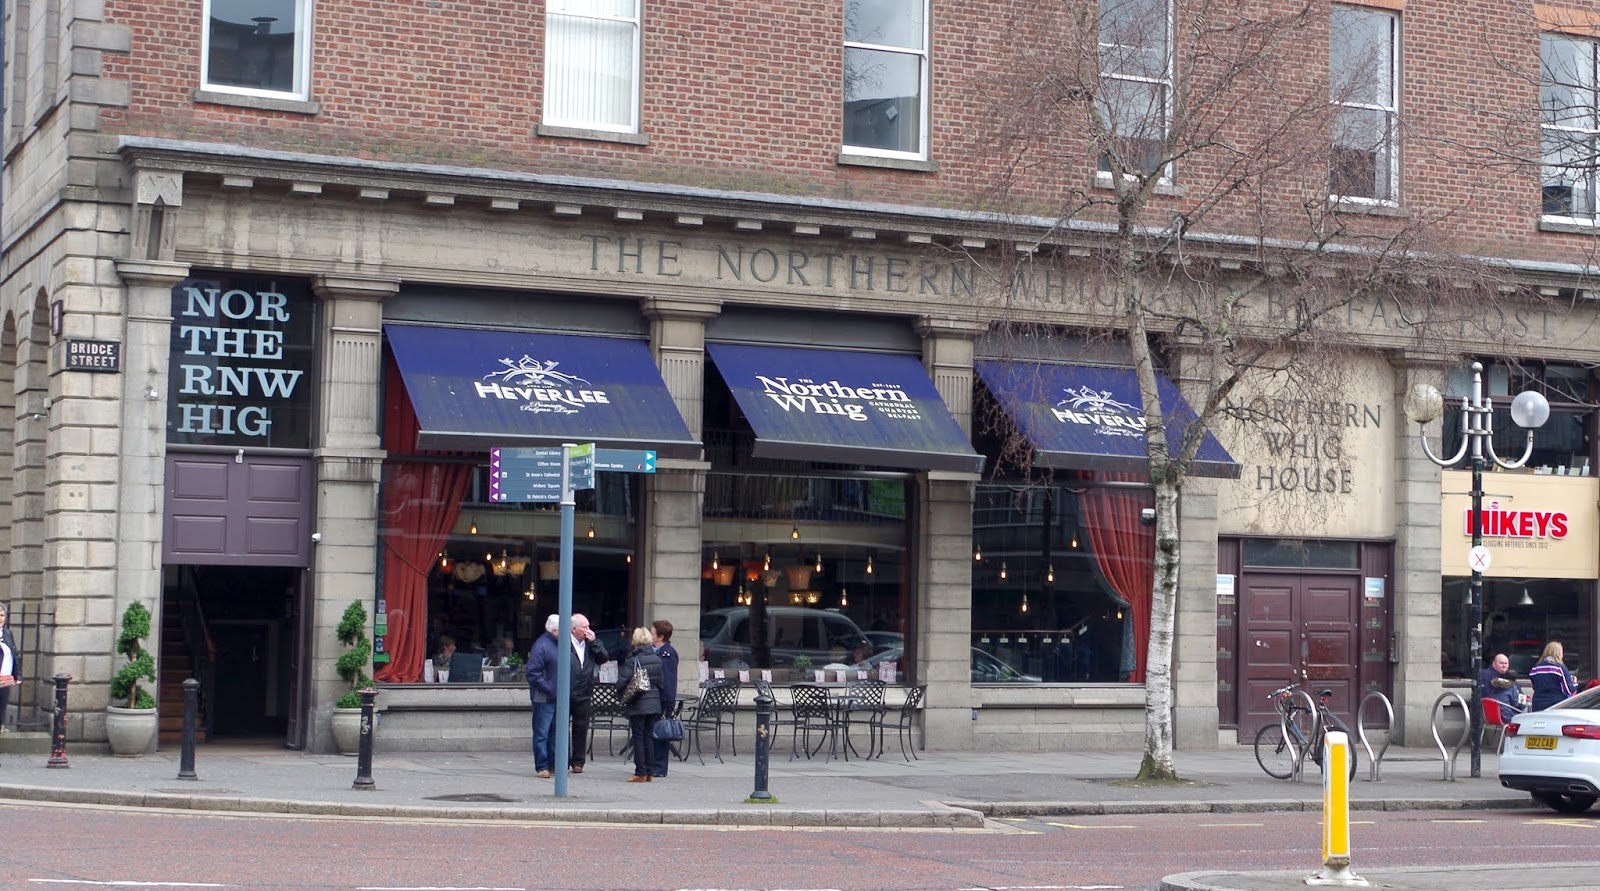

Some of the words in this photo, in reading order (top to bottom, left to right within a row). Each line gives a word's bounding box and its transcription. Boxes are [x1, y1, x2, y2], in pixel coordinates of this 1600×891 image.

[581, 234, 683, 277] THE
[716, 245, 975, 297] NORTHERN
[182, 287, 290, 322] NOR
[71, 343, 113, 355] BRIDGE
[180, 326, 283, 360] THE
[71, 356, 116, 367] STREET
[179, 364, 303, 398] RNW
[474, 381, 610, 408] HEVERLEE
[756, 376, 911, 402] Northern
[177, 403, 272, 436] HIG
[767, 393, 868, 421] Whig
[1051, 408, 1147, 431] HEVERL
[1224, 396, 1381, 428] NORTHERN
[1265, 431, 1341, 459] WHIG
[1256, 465, 1352, 493] HOUSE
